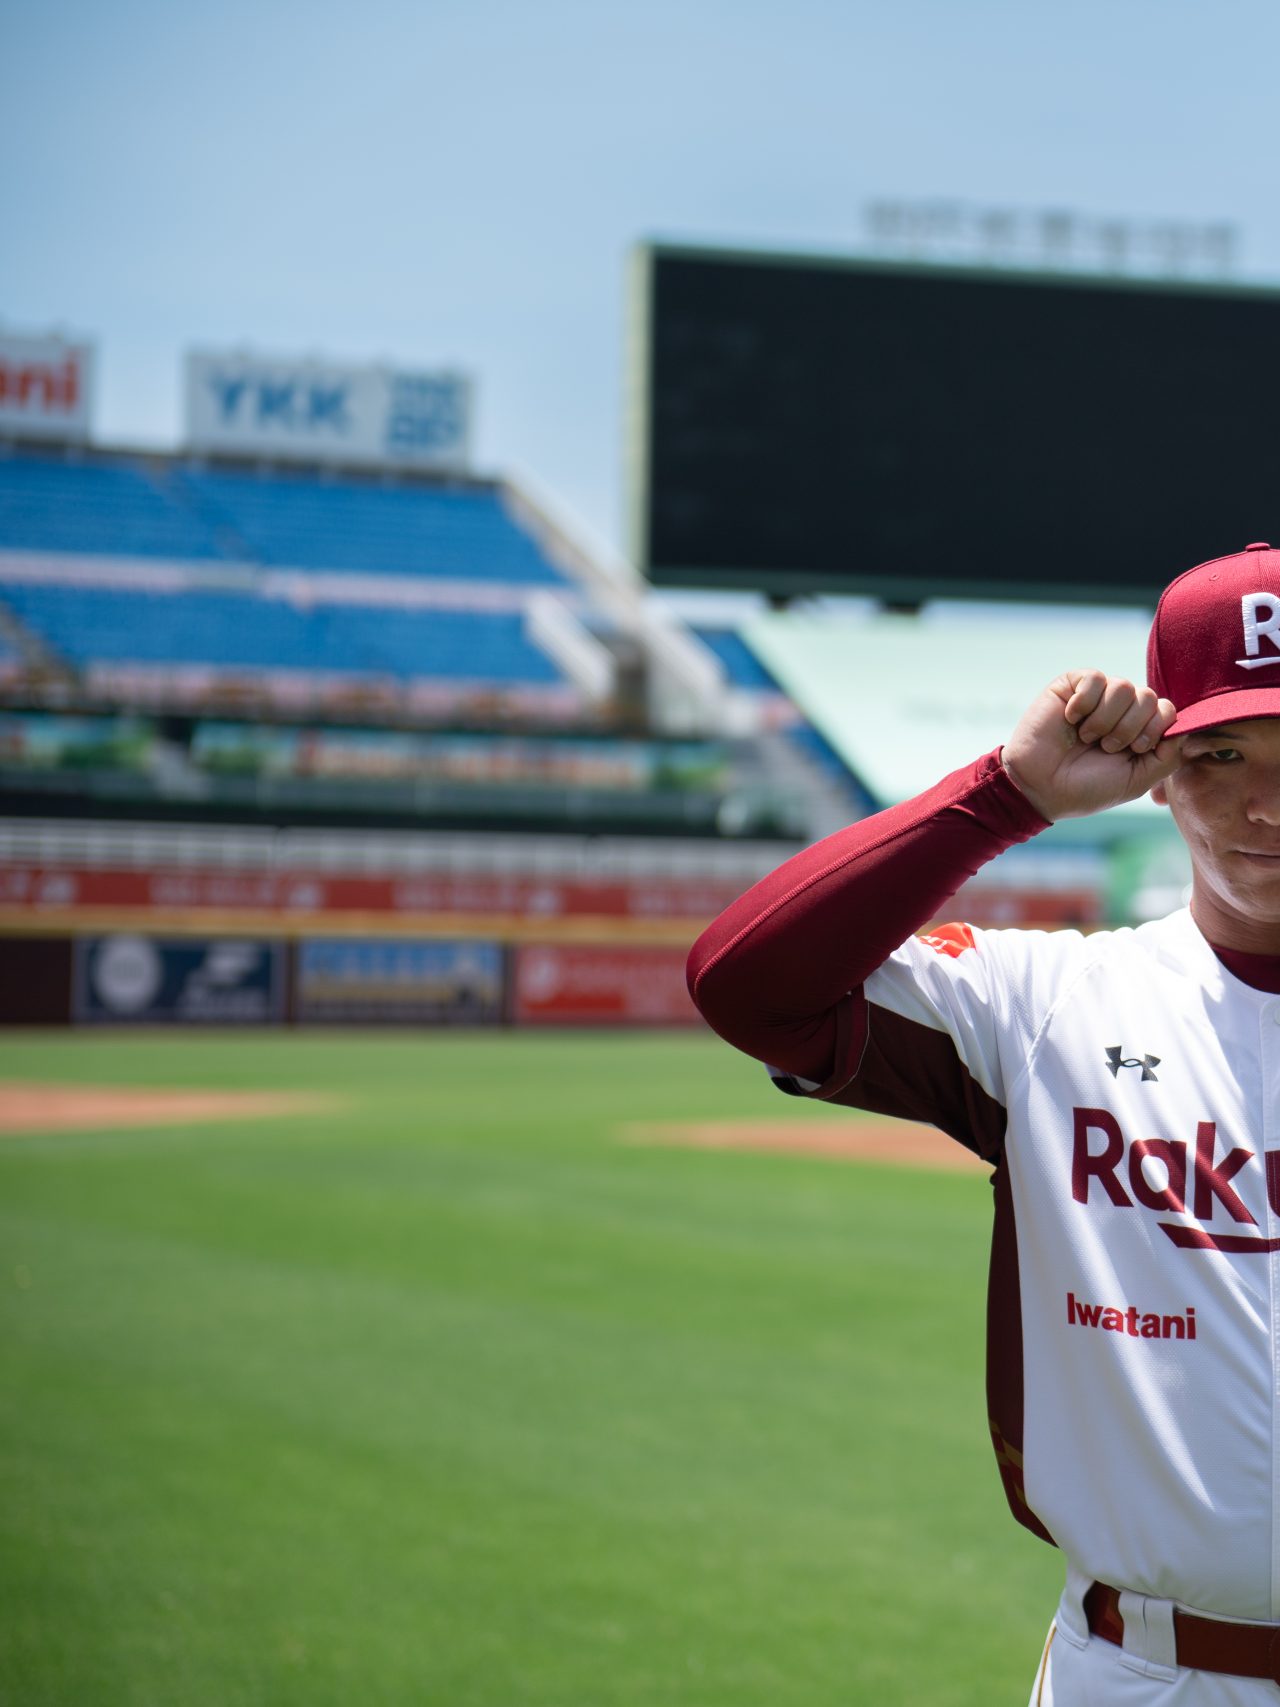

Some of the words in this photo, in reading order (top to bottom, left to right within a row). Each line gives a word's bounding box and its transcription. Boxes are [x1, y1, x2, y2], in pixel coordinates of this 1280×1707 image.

[0, 352, 77, 413] ni
[209, 373, 353, 434] YKK
[1067, 1292, 1197, 1340] Iwatani
